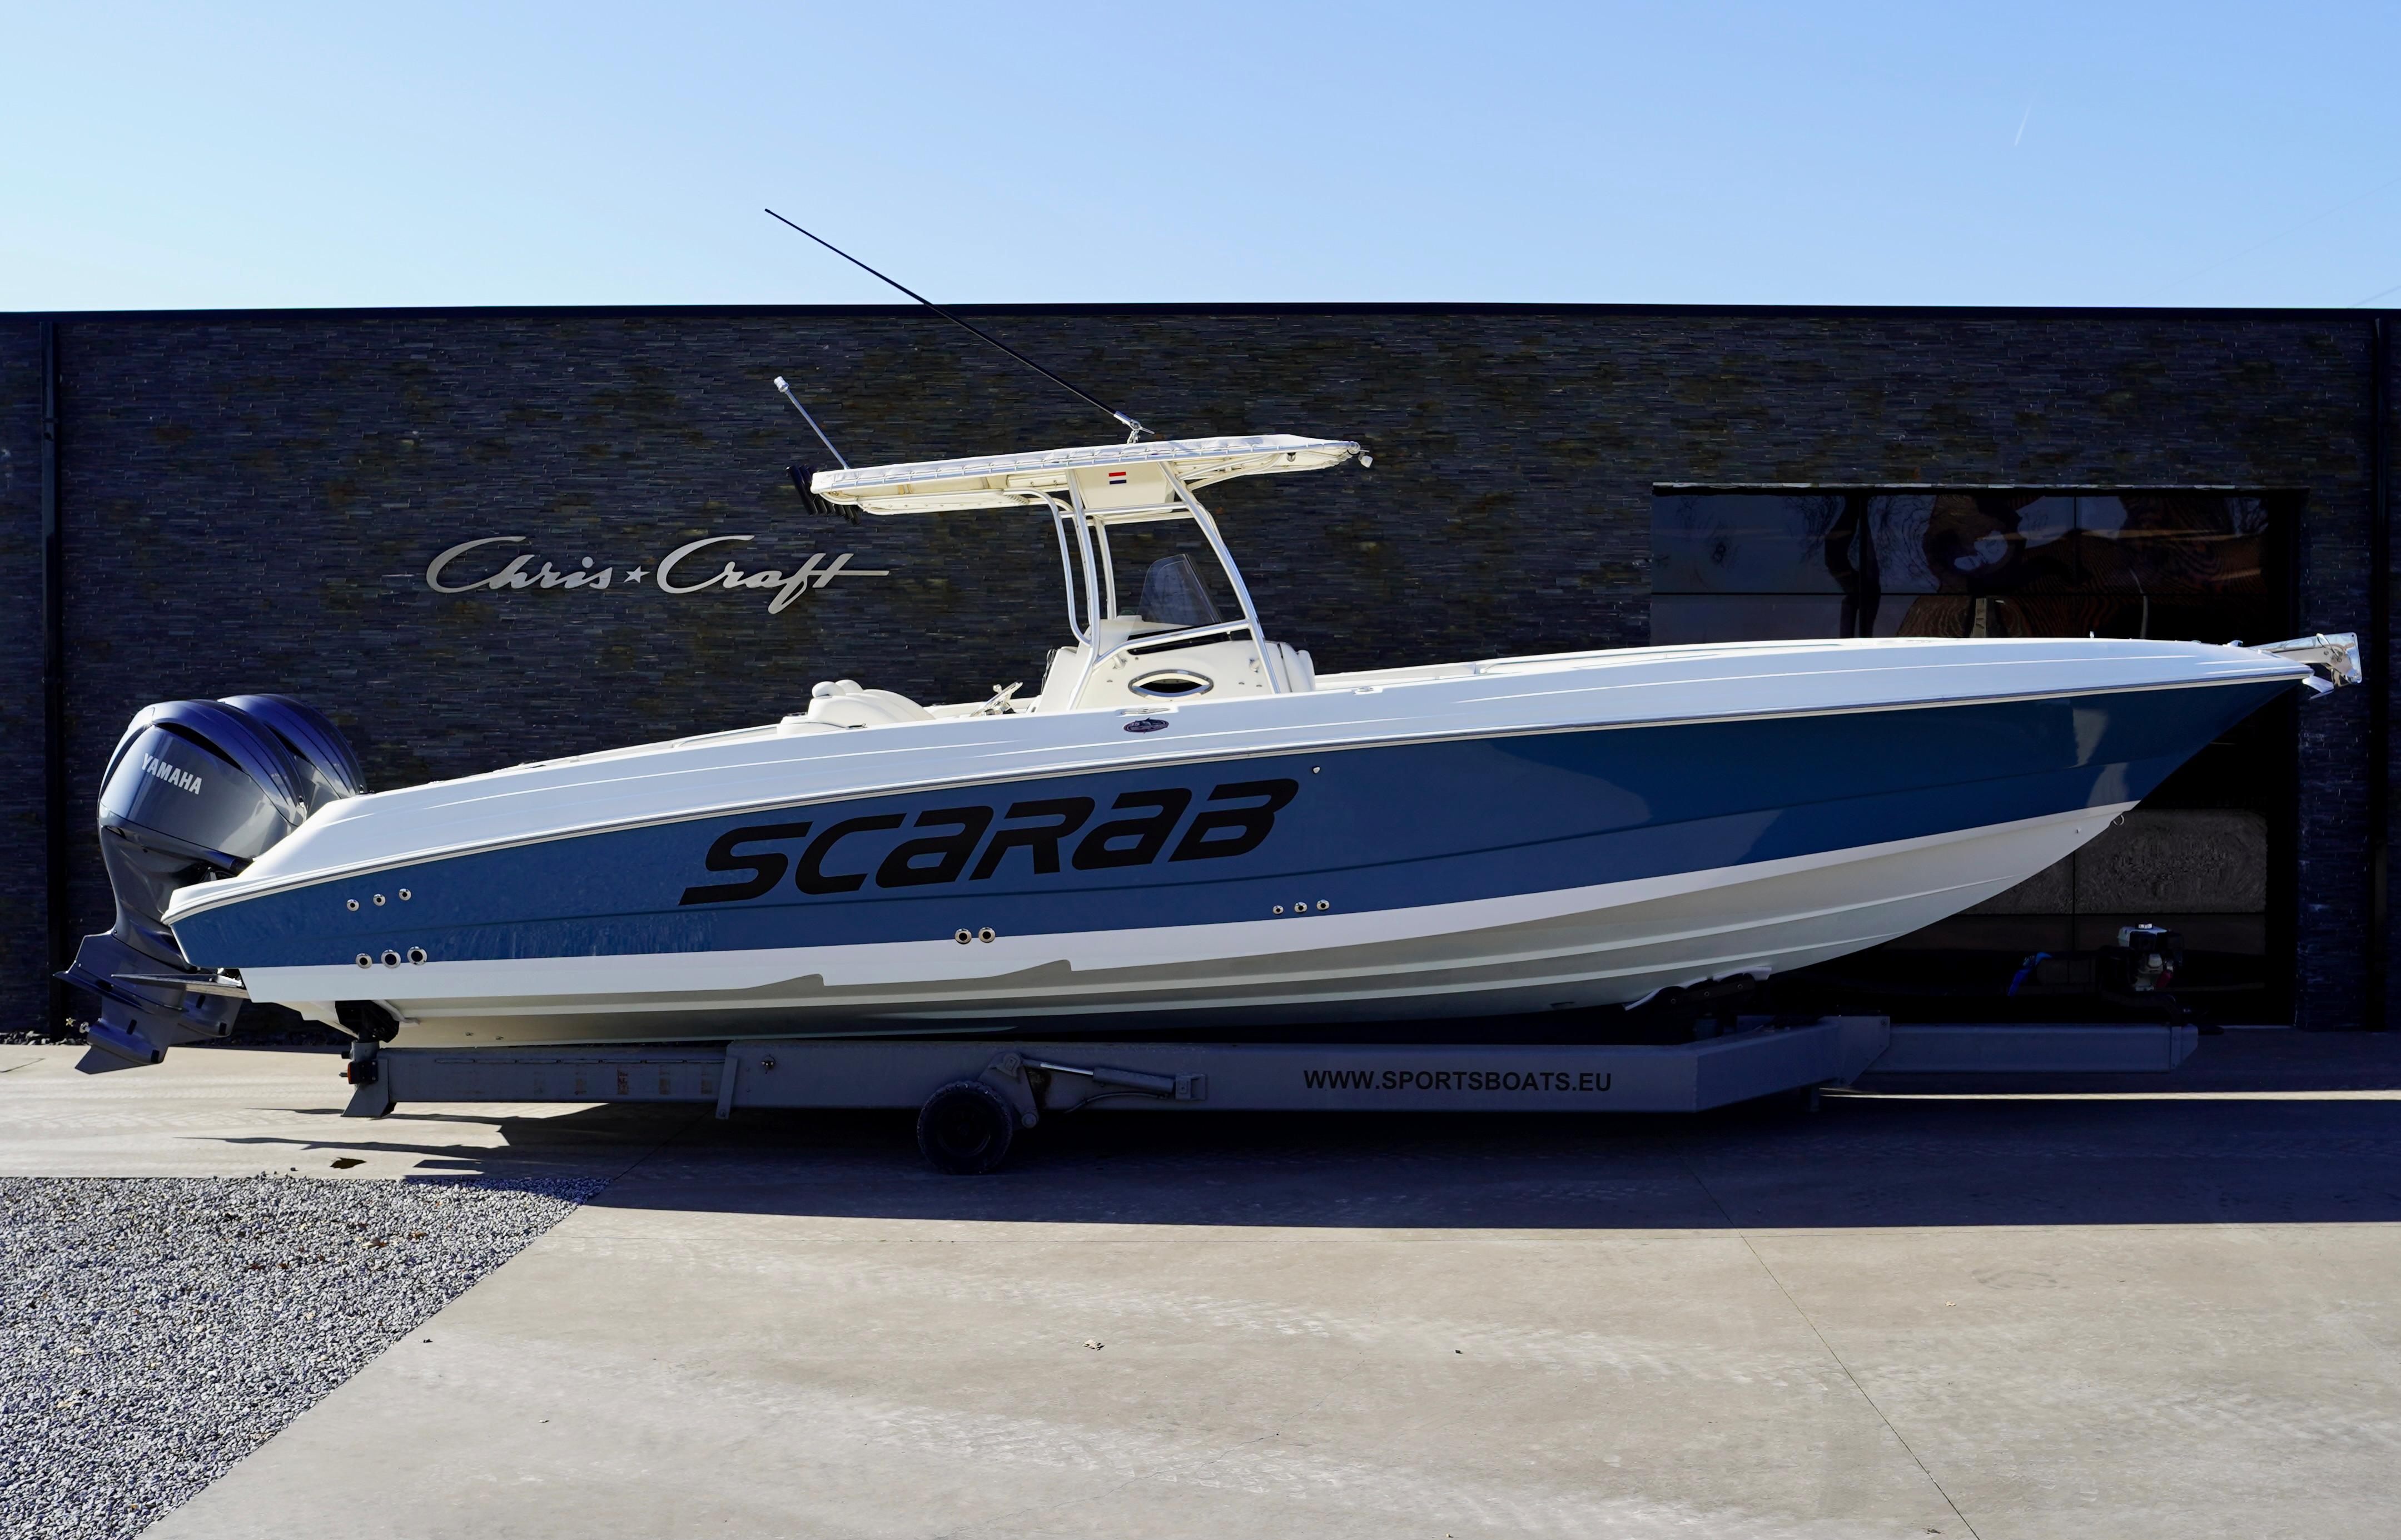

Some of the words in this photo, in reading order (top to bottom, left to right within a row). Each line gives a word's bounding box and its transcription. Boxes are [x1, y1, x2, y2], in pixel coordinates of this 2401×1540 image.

[426, 536, 613, 594] Chris
[657, 535, 889, 615] Craft
[141, 752, 202, 795] YAMAHA
[1303, 1070, 1612, 1092] WWW.SPORTSBOATS.EU
